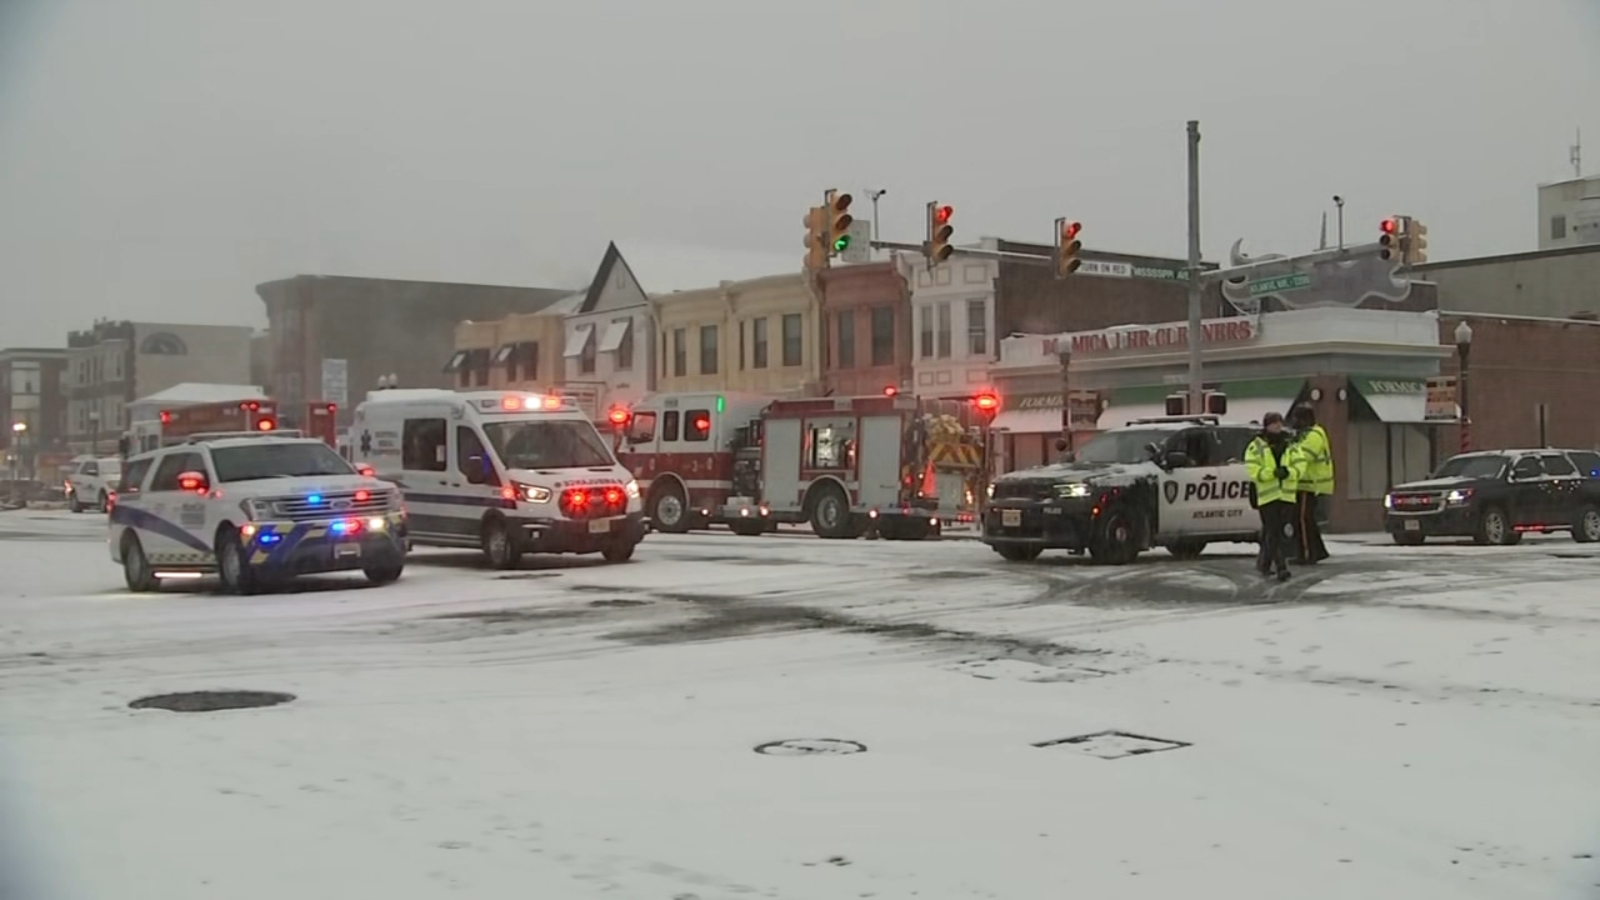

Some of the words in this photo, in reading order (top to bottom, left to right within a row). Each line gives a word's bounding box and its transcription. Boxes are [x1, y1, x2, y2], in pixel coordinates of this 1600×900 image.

[1127, 330, 1150, 348] HR
[1155, 320, 1252, 347] CLENERS
[1184, 480, 1250, 501] POLICE
[1192, 510, 1225, 519] ATLANTIC
[1227, 509, 1243, 518] CITY
